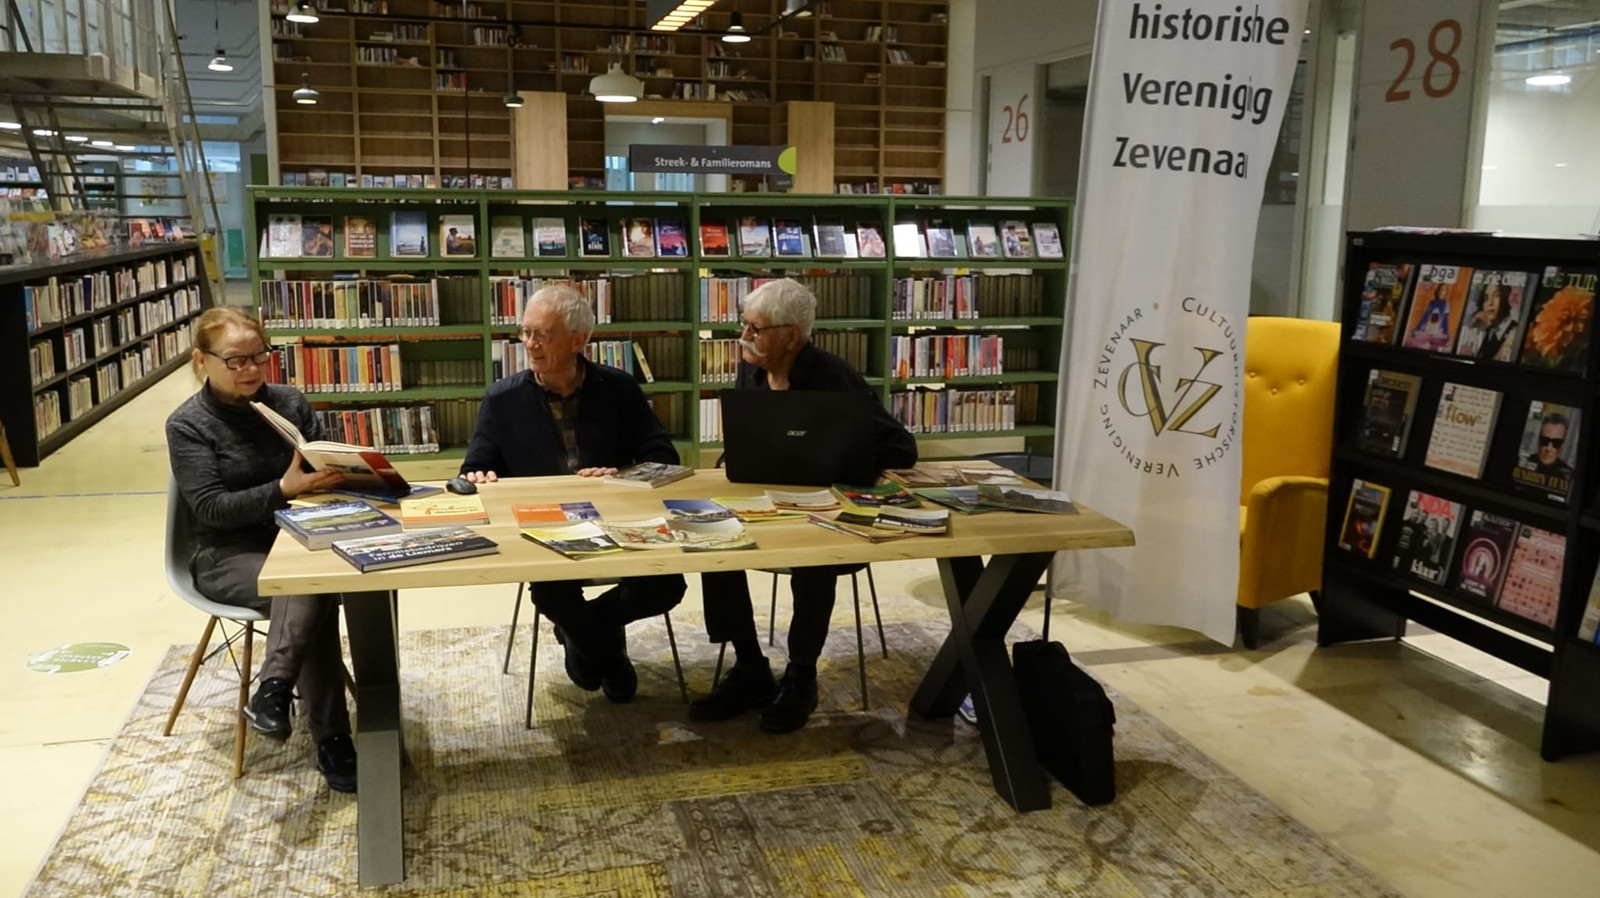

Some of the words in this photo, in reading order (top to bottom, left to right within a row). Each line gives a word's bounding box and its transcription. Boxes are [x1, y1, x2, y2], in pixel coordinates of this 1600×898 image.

[1385, 19, 1463, 102] 28
[1002, 94, 1028, 143] 26
[654, 157, 689, 167] Streek-
[690, 157, 699, 167] &
[701, 157, 772, 168] Familieromans
[1112, 136, 1248, 178] Zevenaa
[1093, 307, 1143, 390] ZEVENAAR
[1444, 403, 1480, 428] flow
[1100, 404, 1180, 478] VERENIGING
